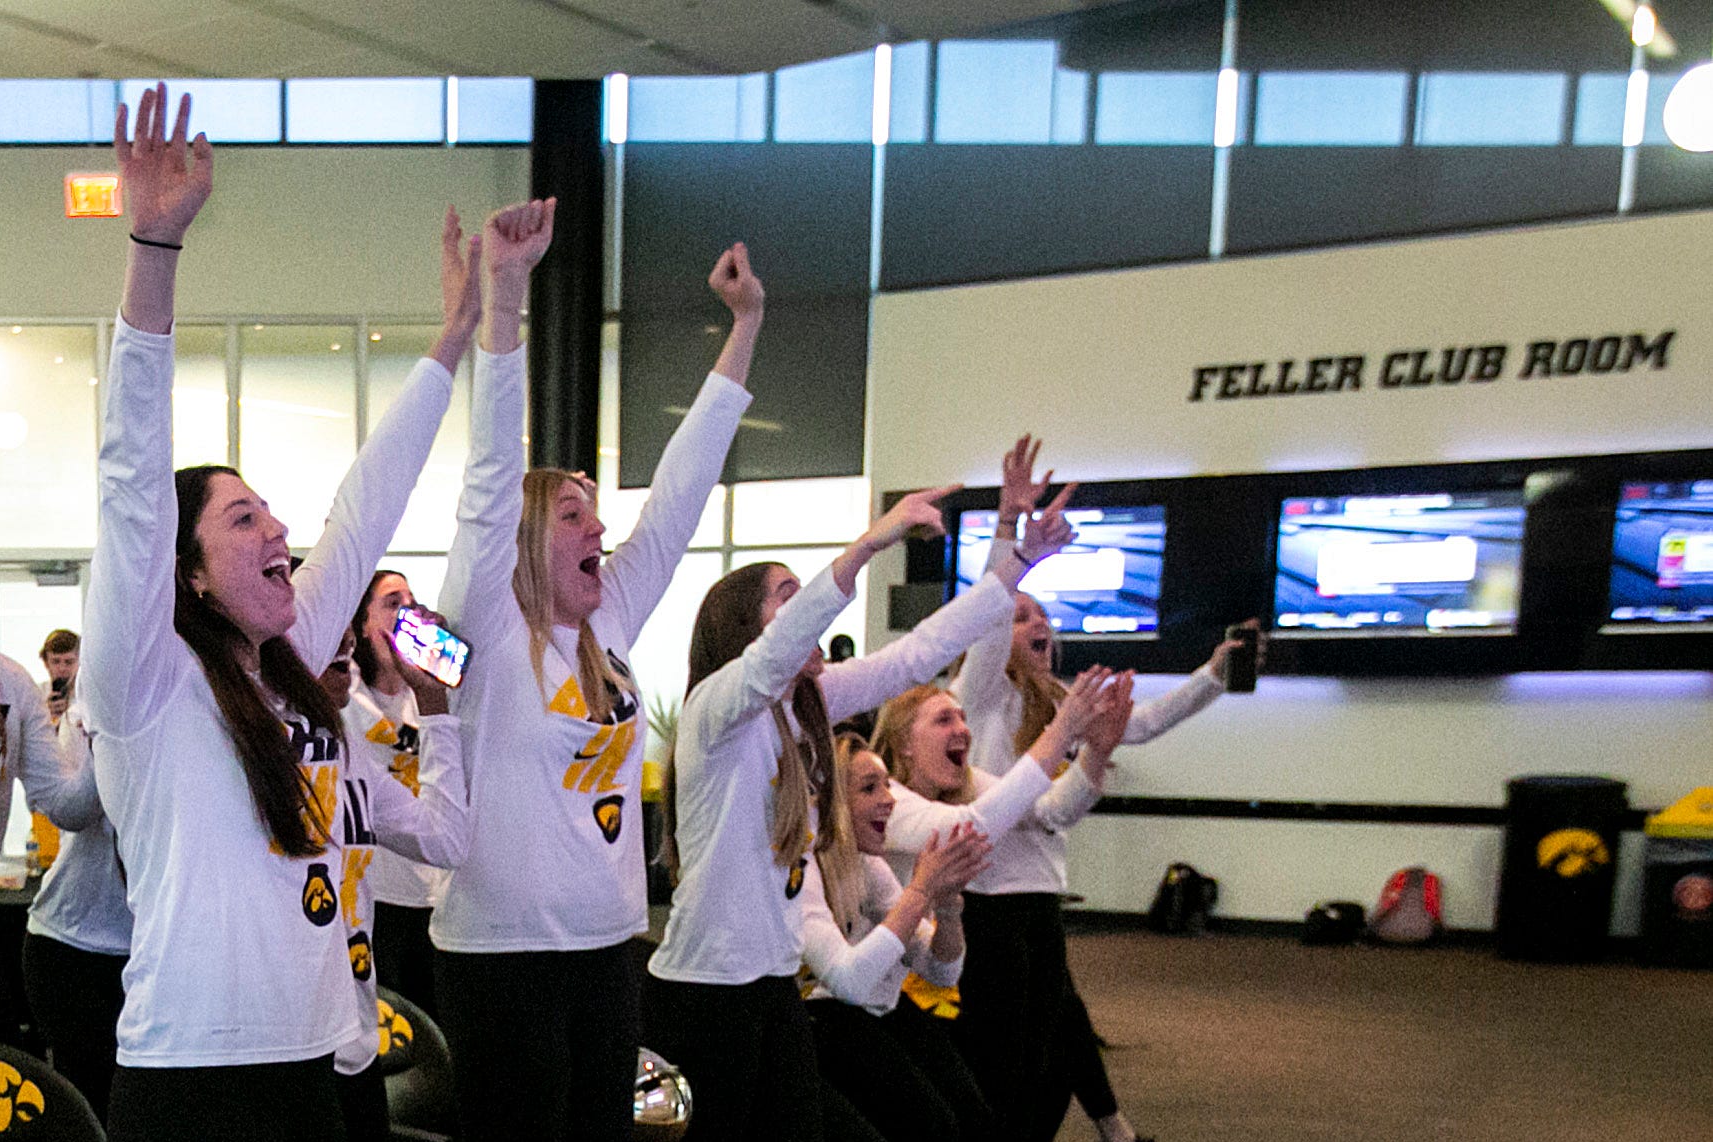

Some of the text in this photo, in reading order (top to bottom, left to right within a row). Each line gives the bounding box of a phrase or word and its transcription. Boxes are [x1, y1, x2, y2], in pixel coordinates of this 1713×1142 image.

[1187, 331, 1676, 402] FELLER CLUB ROOM
